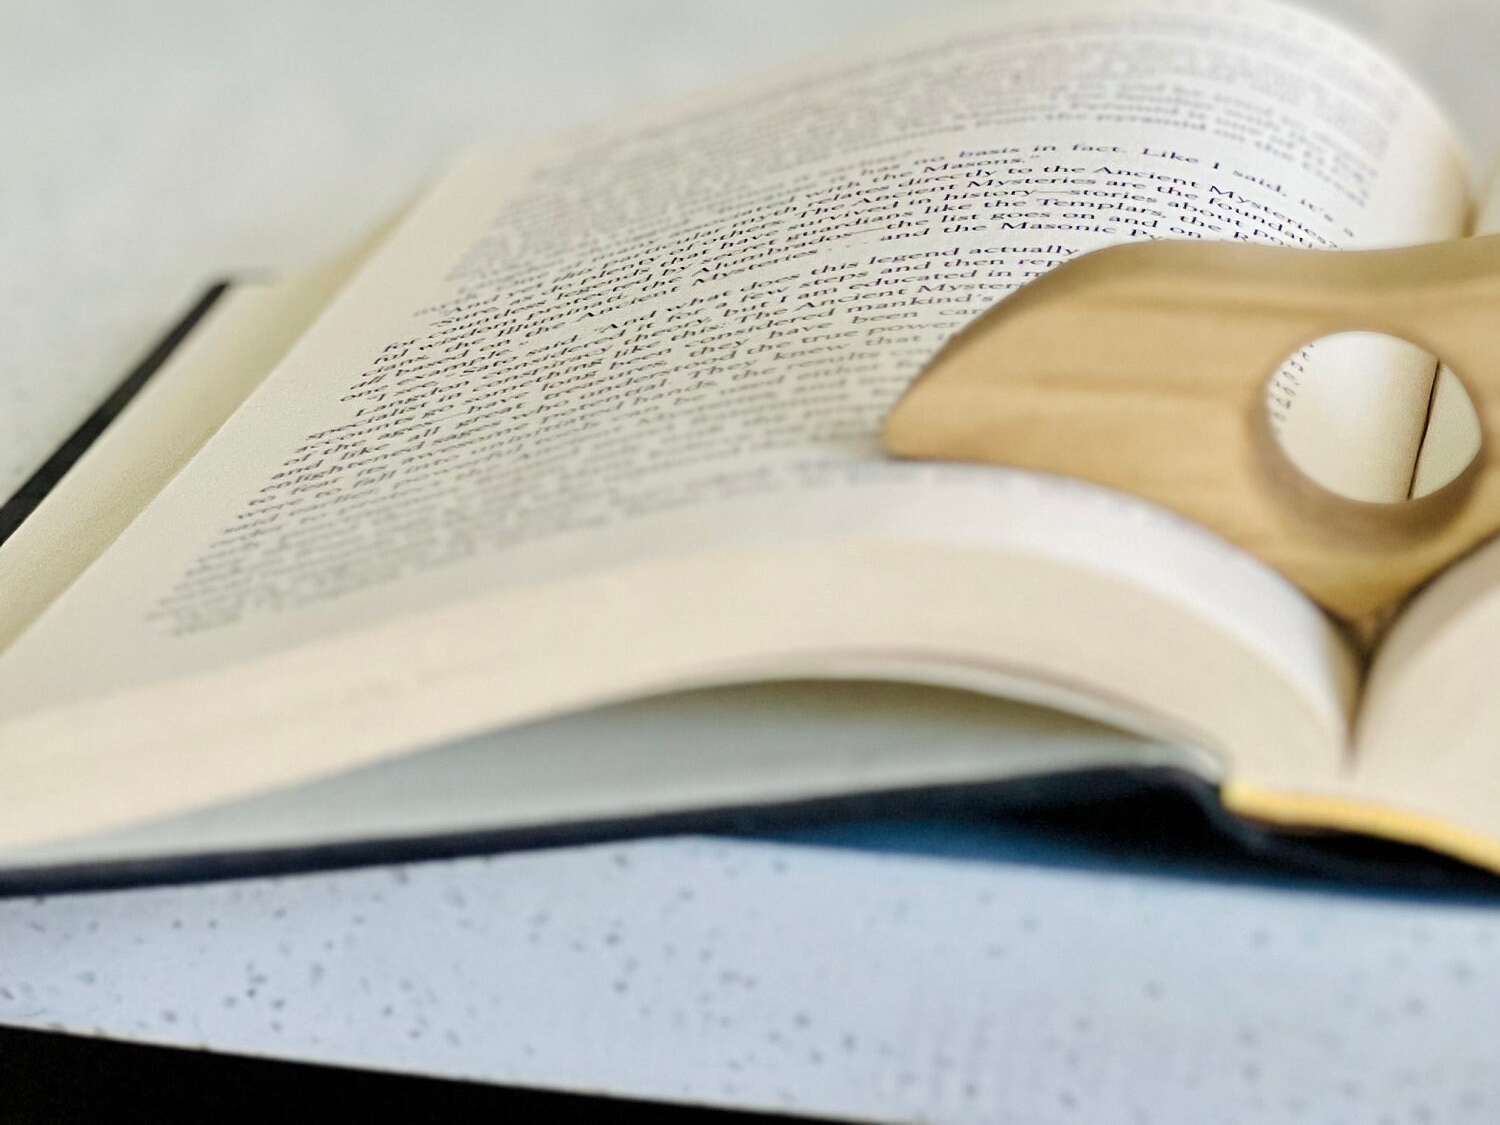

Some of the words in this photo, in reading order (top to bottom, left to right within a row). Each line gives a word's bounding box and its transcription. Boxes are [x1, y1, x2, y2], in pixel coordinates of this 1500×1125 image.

[960, 147, 1020, 158] basis
[1035, 145, 1056, 153] in
[1143, 148, 1198, 163] Like
[668, 239, 699, 255] of
[795, 203, 846, 218] The
[848, 182, 958, 207] Ancient
[967, 177, 1097, 188] Mysteries
[1106, 180, 1146, 189] are
[1157, 186, 1198, 200] the
[719, 229, 780, 248] have
[786, 200, 899, 231] survived
[908, 197, 932, 206] in
[1168, 202, 1241, 227] about
[731, 203, 798, 227] myth
[806, 184, 891, 207] relates
[897, 168, 998, 187] directly
[1007, 166, 1033, 174] to
[1043, 165, 1086, 173] the
[1093, 166, 1198, 187] Ancient
[941, 212, 980, 222] list
[990, 211, 1051, 221] goes
[1109, 216, 1157, 227] and
[1170, 227, 1201, 239] on
[661, 262, 693, 276] by
[699, 238, 776, 264] secret
[786, 210, 913, 243] guardians
[924, 202, 973, 213] like
[983, 199, 1028, 208] the
[1181, 215, 1222, 231] the
[691, 249, 817, 286] Mysteries
[879, 226, 931, 241] and
[942, 223, 988, 233] the
[1001, 222, 1117, 234] Masonic
[666, 287, 733, 312] what
[739, 274, 800, 292] does
[810, 261, 859, 275] this
[869, 248, 959, 265] legend
[969, 245, 1079, 256] actually
[666, 306, 706, 322] for
[714, 300, 729, 308] a
[740, 286, 791, 301] few
[798, 271, 869, 289] steps
[880, 262, 930, 274] and
[944, 259, 1004, 268] then
[723, 300, 769, 316] but
[796, 287, 838, 299] am
[849, 270, 977, 290] educated
[988, 270, 1012, 278] in
